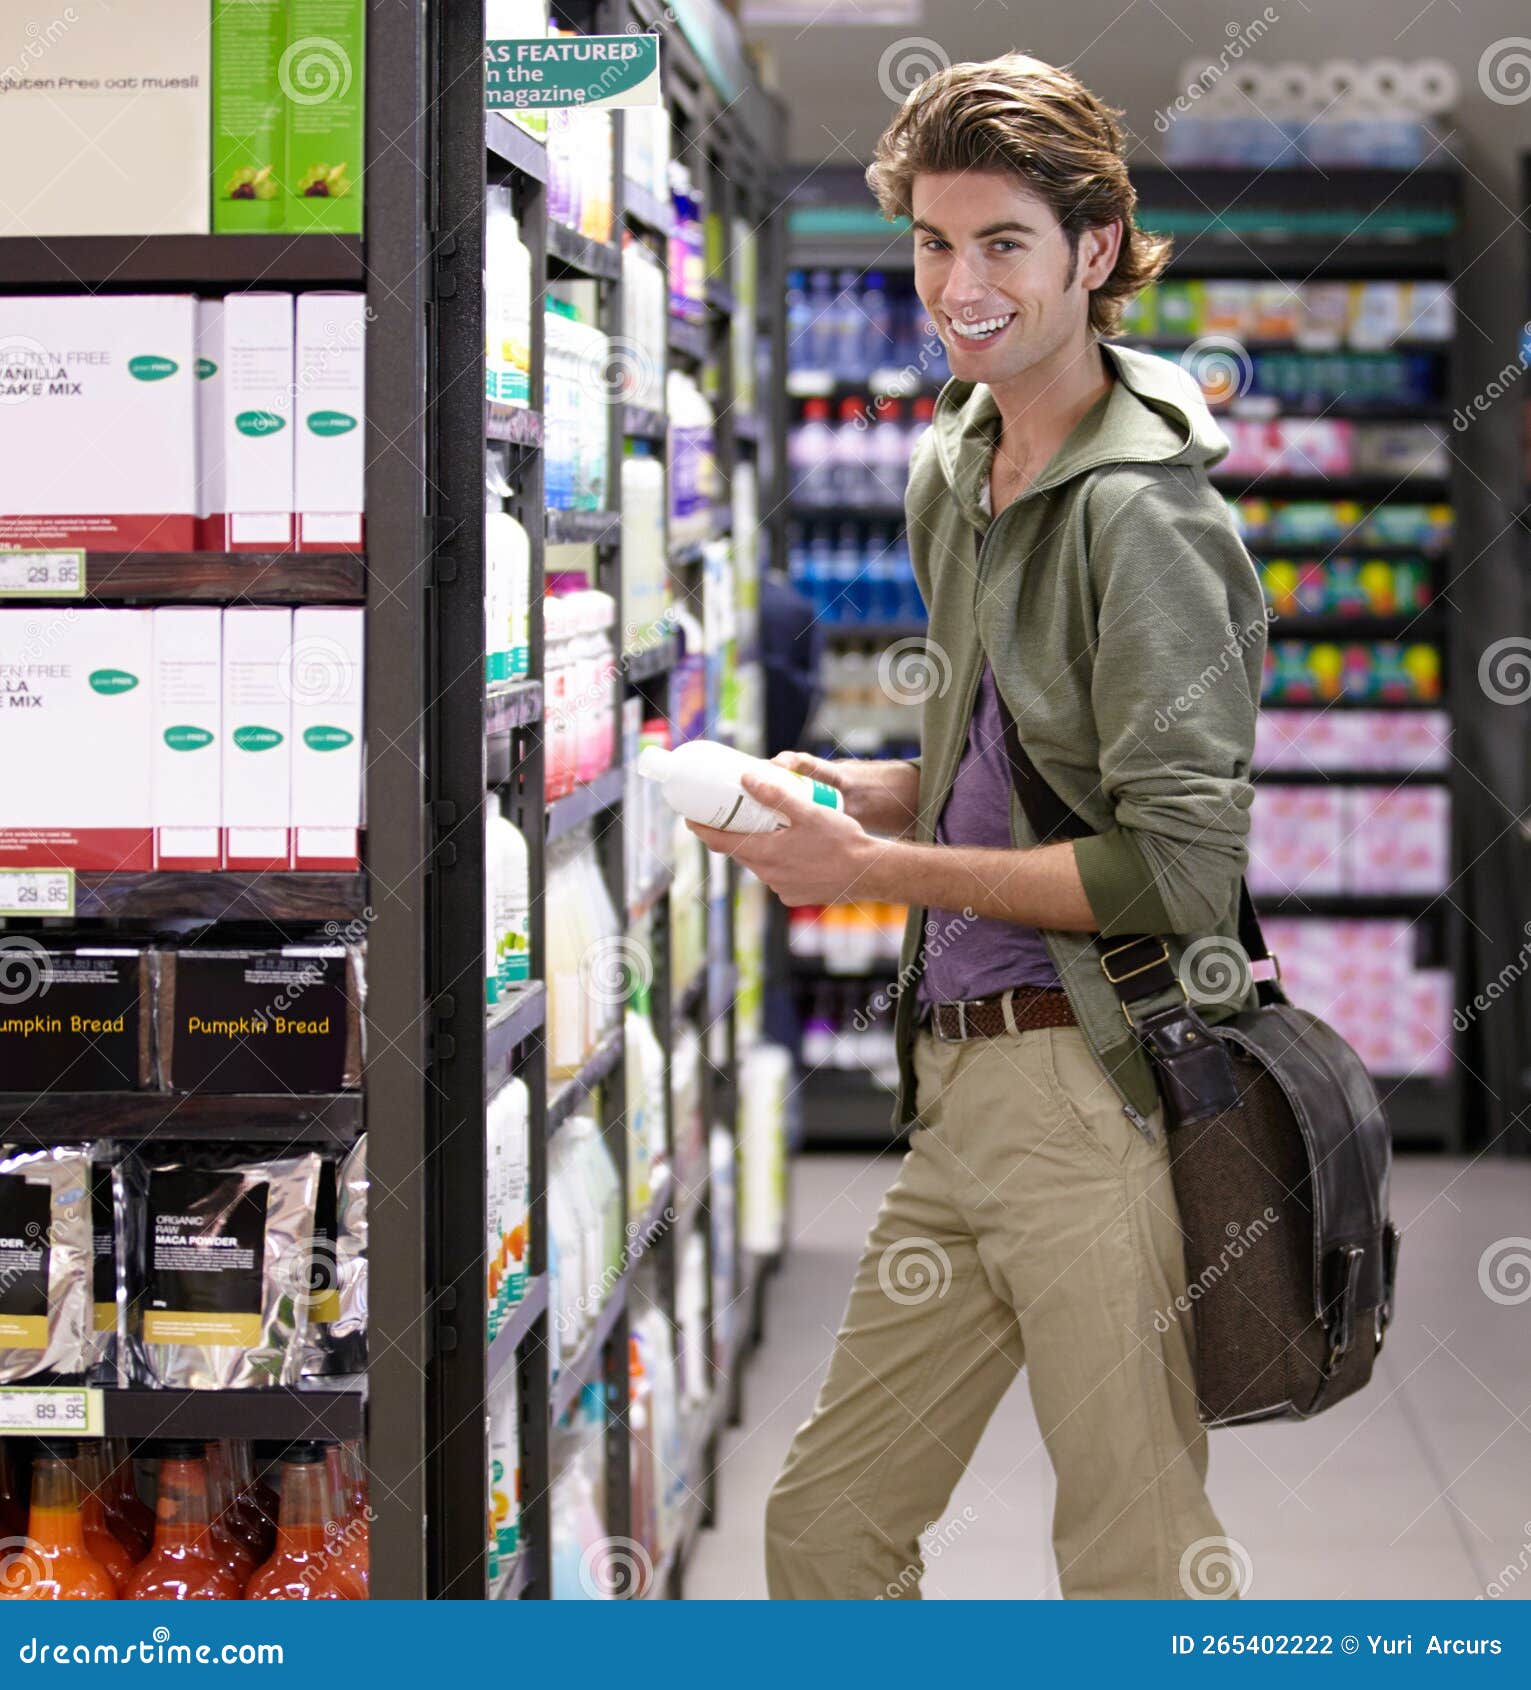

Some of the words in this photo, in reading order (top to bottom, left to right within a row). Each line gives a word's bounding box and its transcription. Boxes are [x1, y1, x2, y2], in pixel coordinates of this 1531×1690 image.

[517, 43, 638, 62] FEATURED
[506, 65, 543, 82] the
[104, 77, 138, 89] oat
[142, 75, 199, 89] muesli
[485, 85, 586, 107] magazine
[67, 352, 110, 365] FREE
[49, 383, 82, 395] MIX
[27, 664, 72, 678] FREE
[9, 696, 42, 708] MIX
[70, 1015, 124, 1033] Bread
[188, 1016, 267, 1039] Pumpkin
[275, 1016, 330, 1034] Bread
[155, 1215, 204, 1226] ORGANIC
[155, 1225, 179, 1234] RAW
[155, 1235, 187, 1246] MACA
[188, 1236, 238, 1247] POWDER
